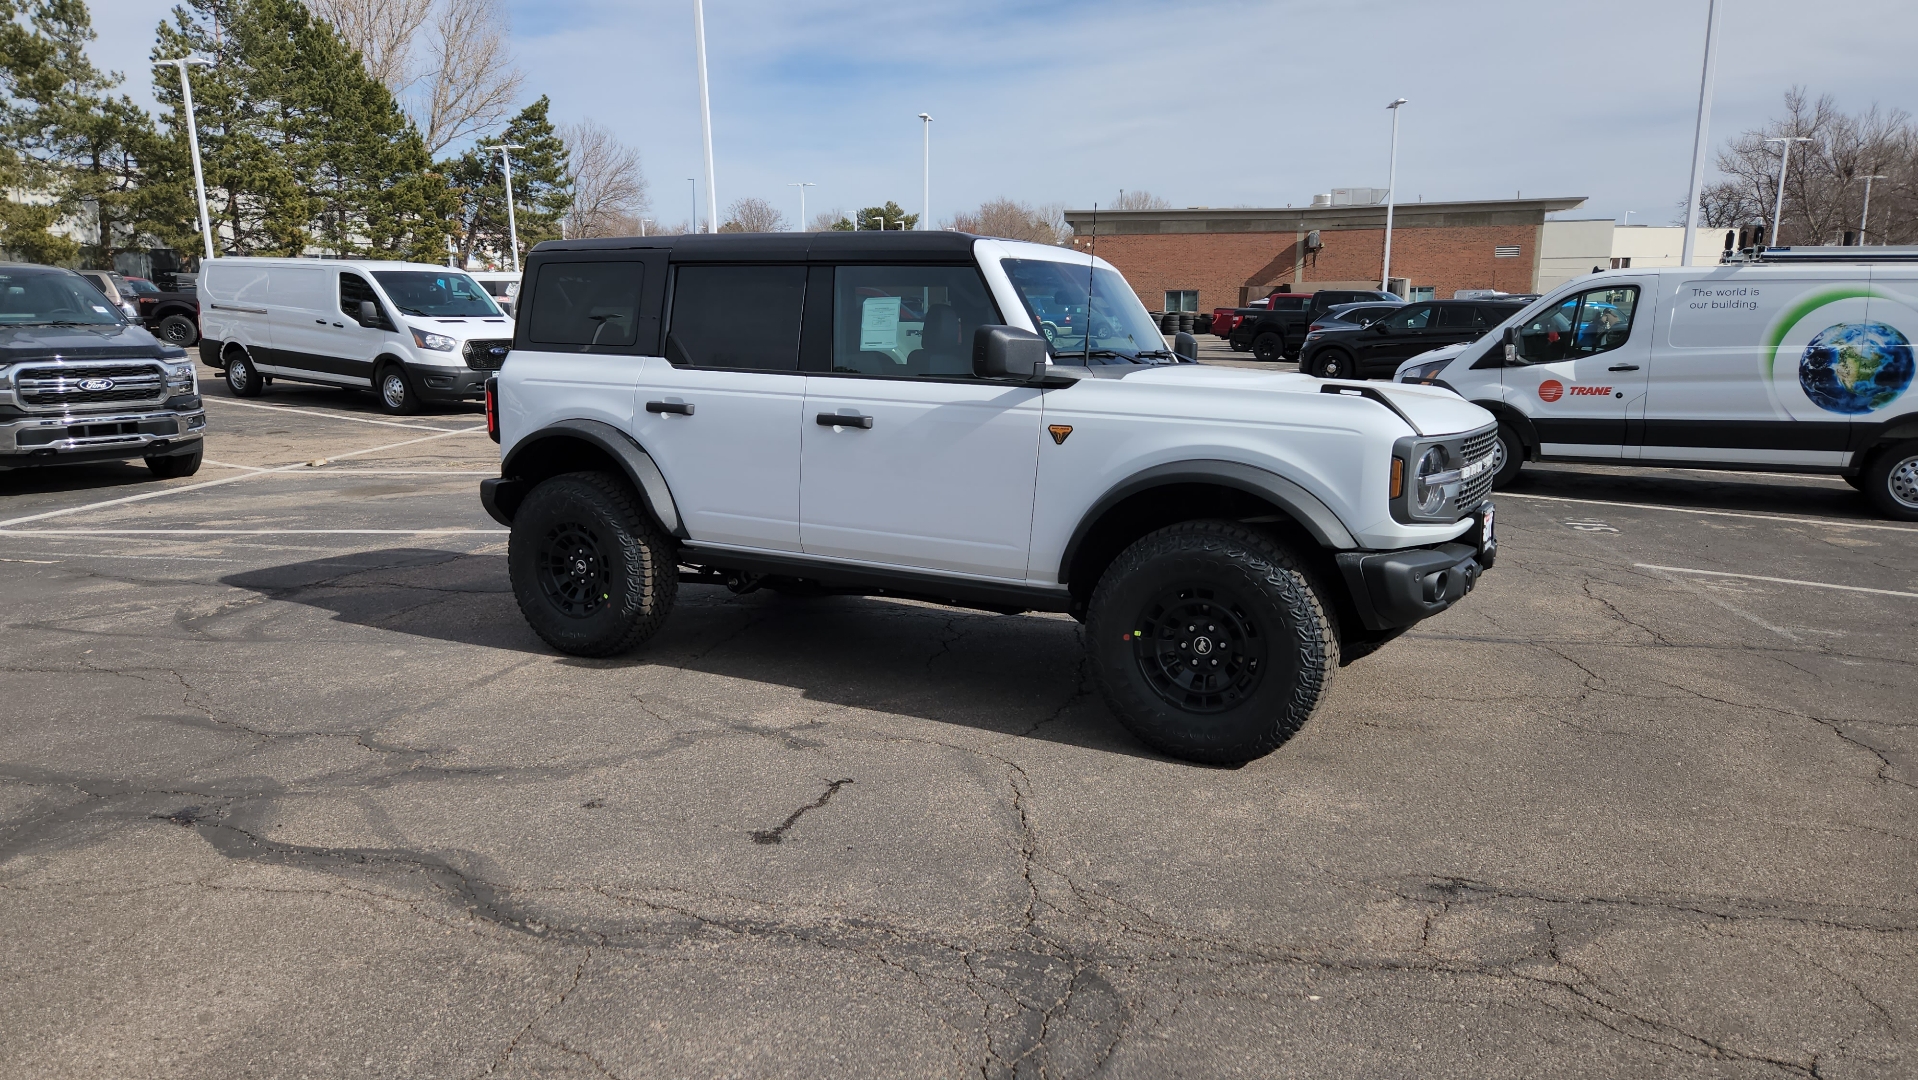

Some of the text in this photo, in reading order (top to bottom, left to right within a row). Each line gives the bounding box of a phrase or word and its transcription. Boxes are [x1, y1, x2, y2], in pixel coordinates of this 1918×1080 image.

[1692, 288, 1760, 297] The world is
[1711, 300, 1759, 311] building.
[84, 380, 108, 389] Ford
[1570, 386, 1612, 396] TRANE
